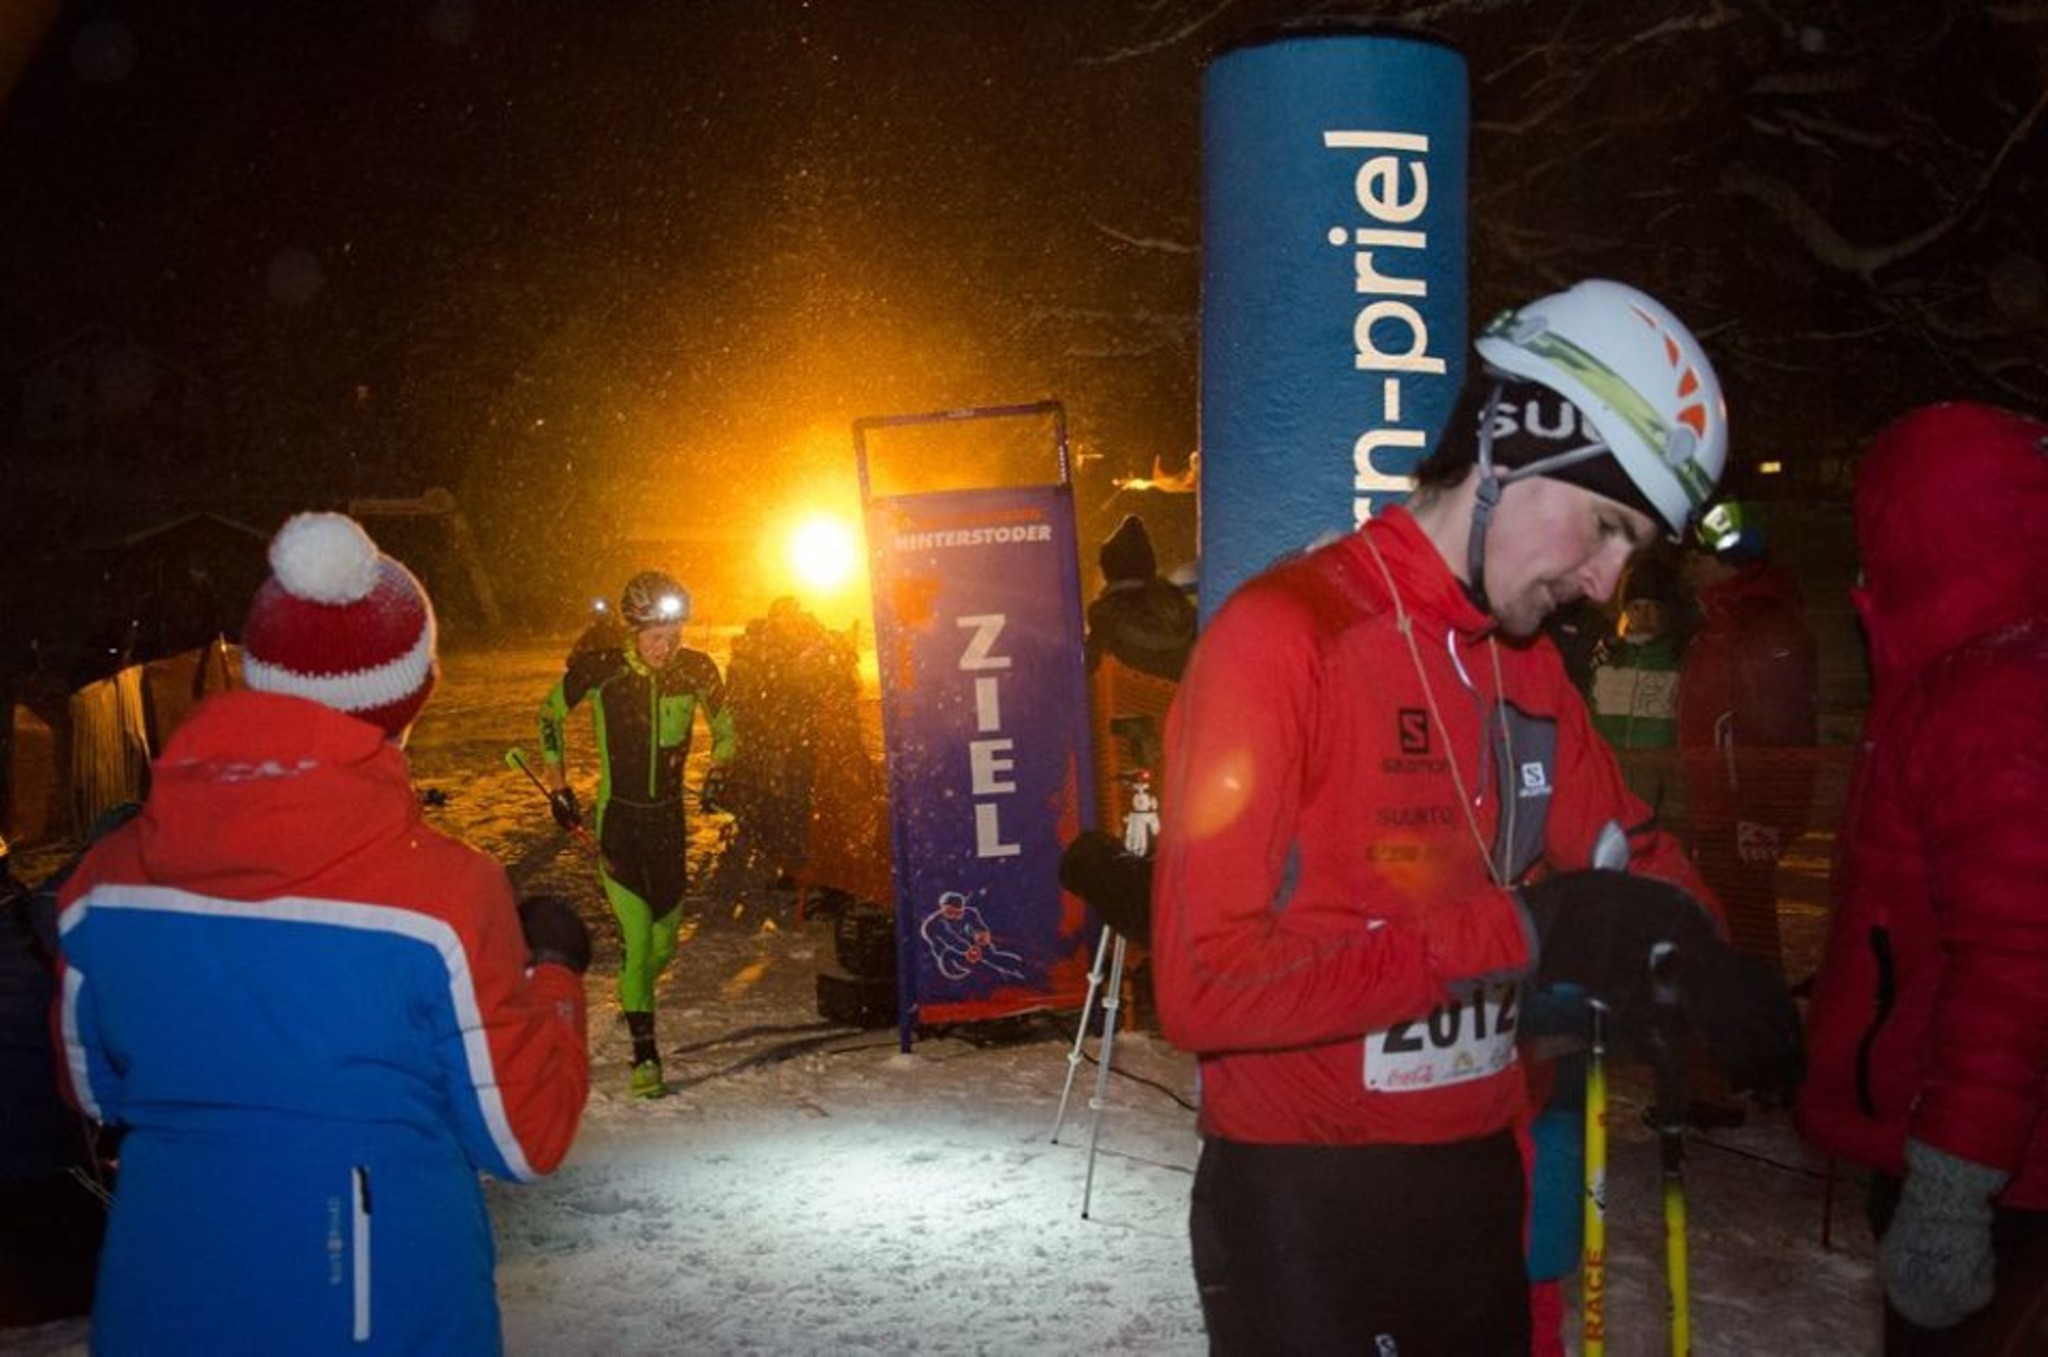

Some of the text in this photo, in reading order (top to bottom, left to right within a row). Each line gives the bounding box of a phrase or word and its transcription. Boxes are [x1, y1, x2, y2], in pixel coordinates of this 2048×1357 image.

[894, 525, 1052, 550] HINTERSTODER
[957, 614, 1021, 858] ZIEL
[1586, 1247, 1604, 1341] RACE
